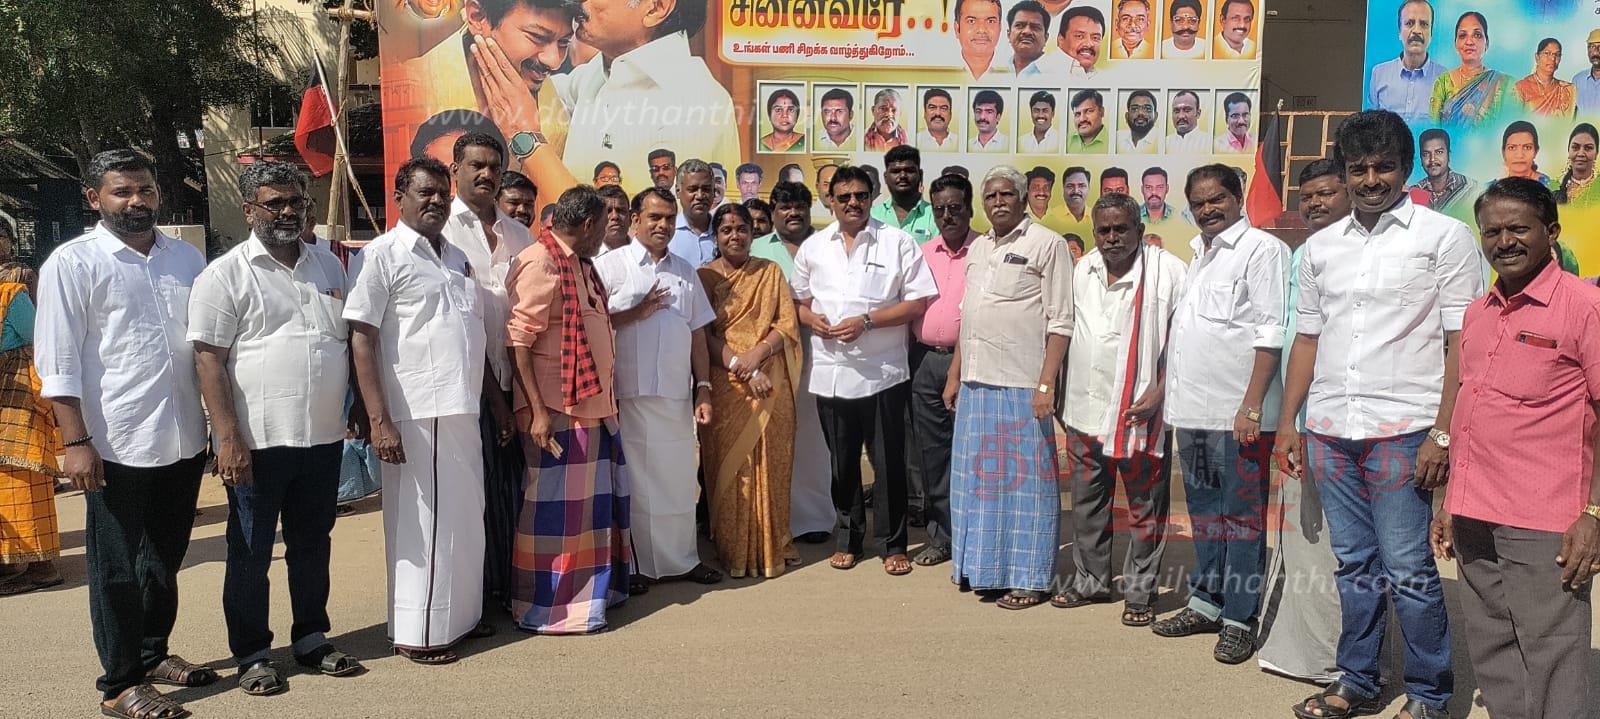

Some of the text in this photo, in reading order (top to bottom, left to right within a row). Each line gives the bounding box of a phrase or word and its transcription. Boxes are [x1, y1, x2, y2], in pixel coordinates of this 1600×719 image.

[733, 41, 771, 53] உங்கள்
[772, 42, 795, 54] பணி
[797, 42, 828, 57] சிறக்க
